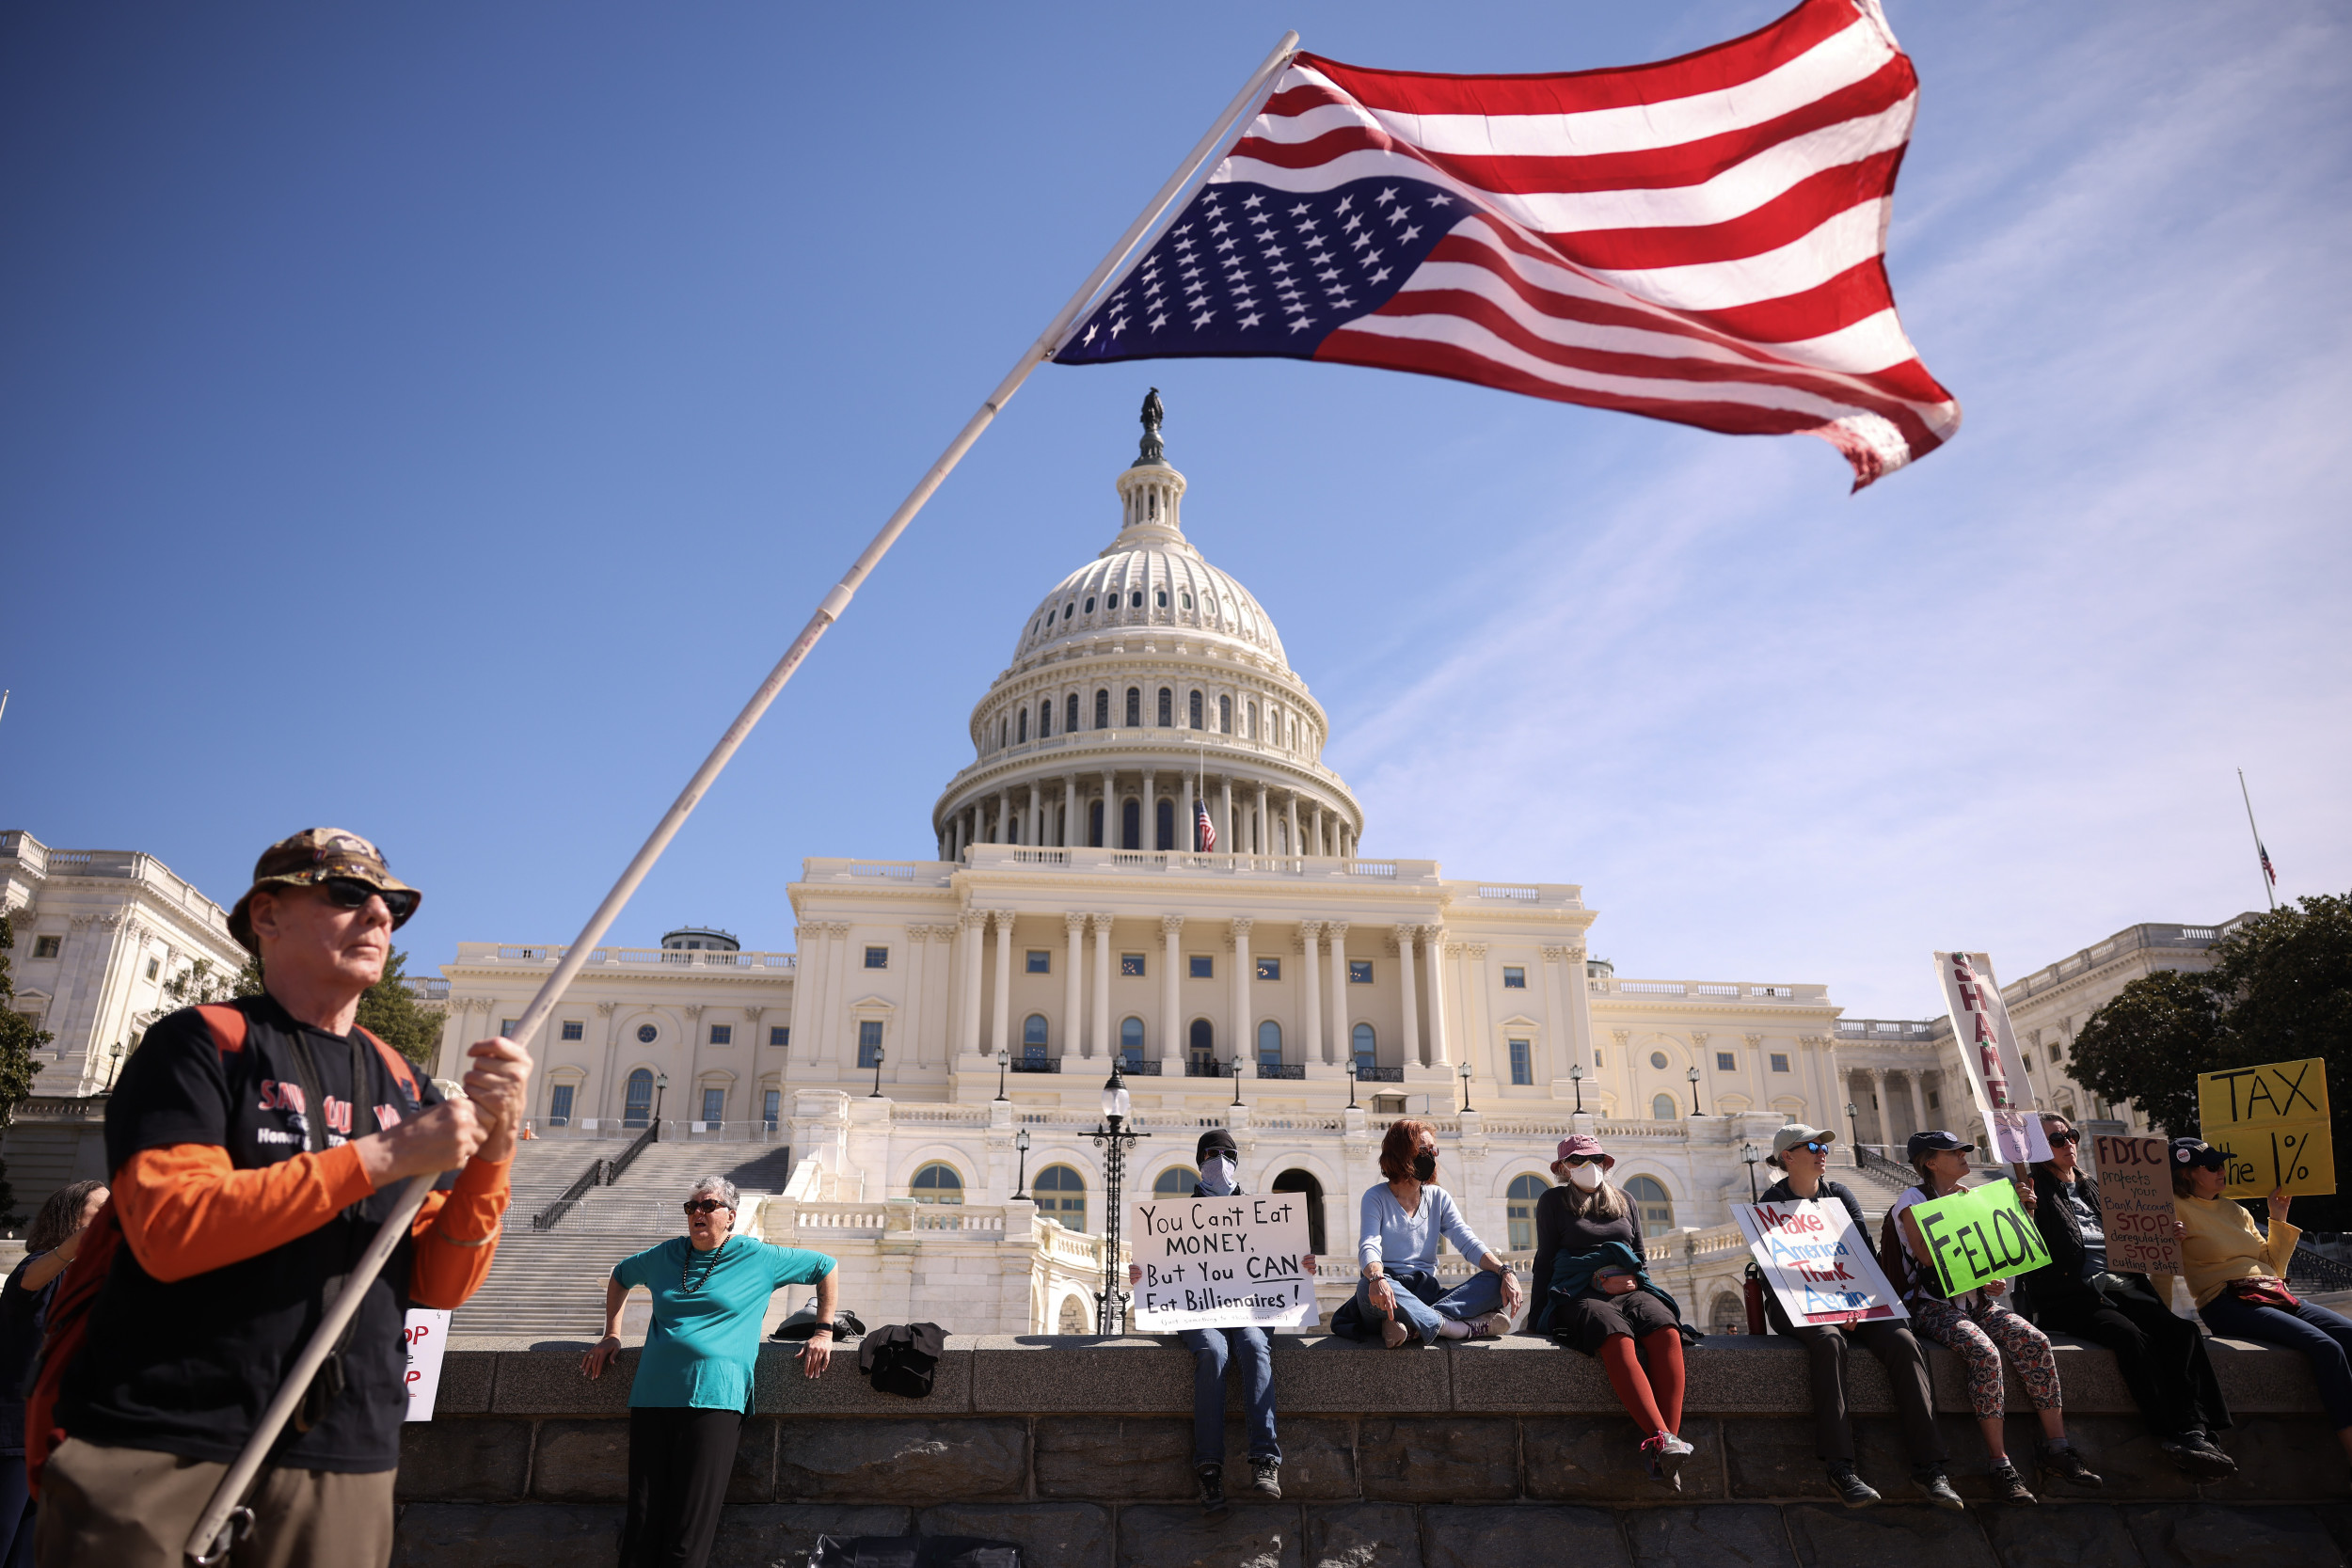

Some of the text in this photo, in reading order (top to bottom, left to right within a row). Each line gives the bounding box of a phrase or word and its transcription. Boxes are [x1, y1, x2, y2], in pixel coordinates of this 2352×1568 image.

[1951, 952, 2016, 1109] SHAME
[2211, 1063, 2318, 1122] TAX
[2097, 1136, 2162, 1165] FDIC
[2271, 1132, 2309, 1188] 1%
[2102, 1169, 2151, 1189] protects
[2130, 1187, 2157, 1198] your
[2104, 1196, 2132, 1212] Bank
[2135, 1199, 2174, 1214] Accounts
[1139, 1200, 1292, 1236] You Can't Eat
[1753, 1204, 1824, 1235] Make
[2117, 1212, 2169, 1234] STOP
[1166, 1233, 1255, 1257] MONEY,
[2110, 1228, 2176, 1246] deregulation
[1771, 1236, 1850, 1265] America
[2123, 1243, 2173, 1261] STOP
[1147, 1254, 1298, 1288] But You CAN
[1788, 1259, 1855, 1283] Think
[2112, 1257, 2179, 1275] cutting staff
[1146, 1292, 1178, 1314] Eat
[1804, 1284, 1871, 1313] Again
